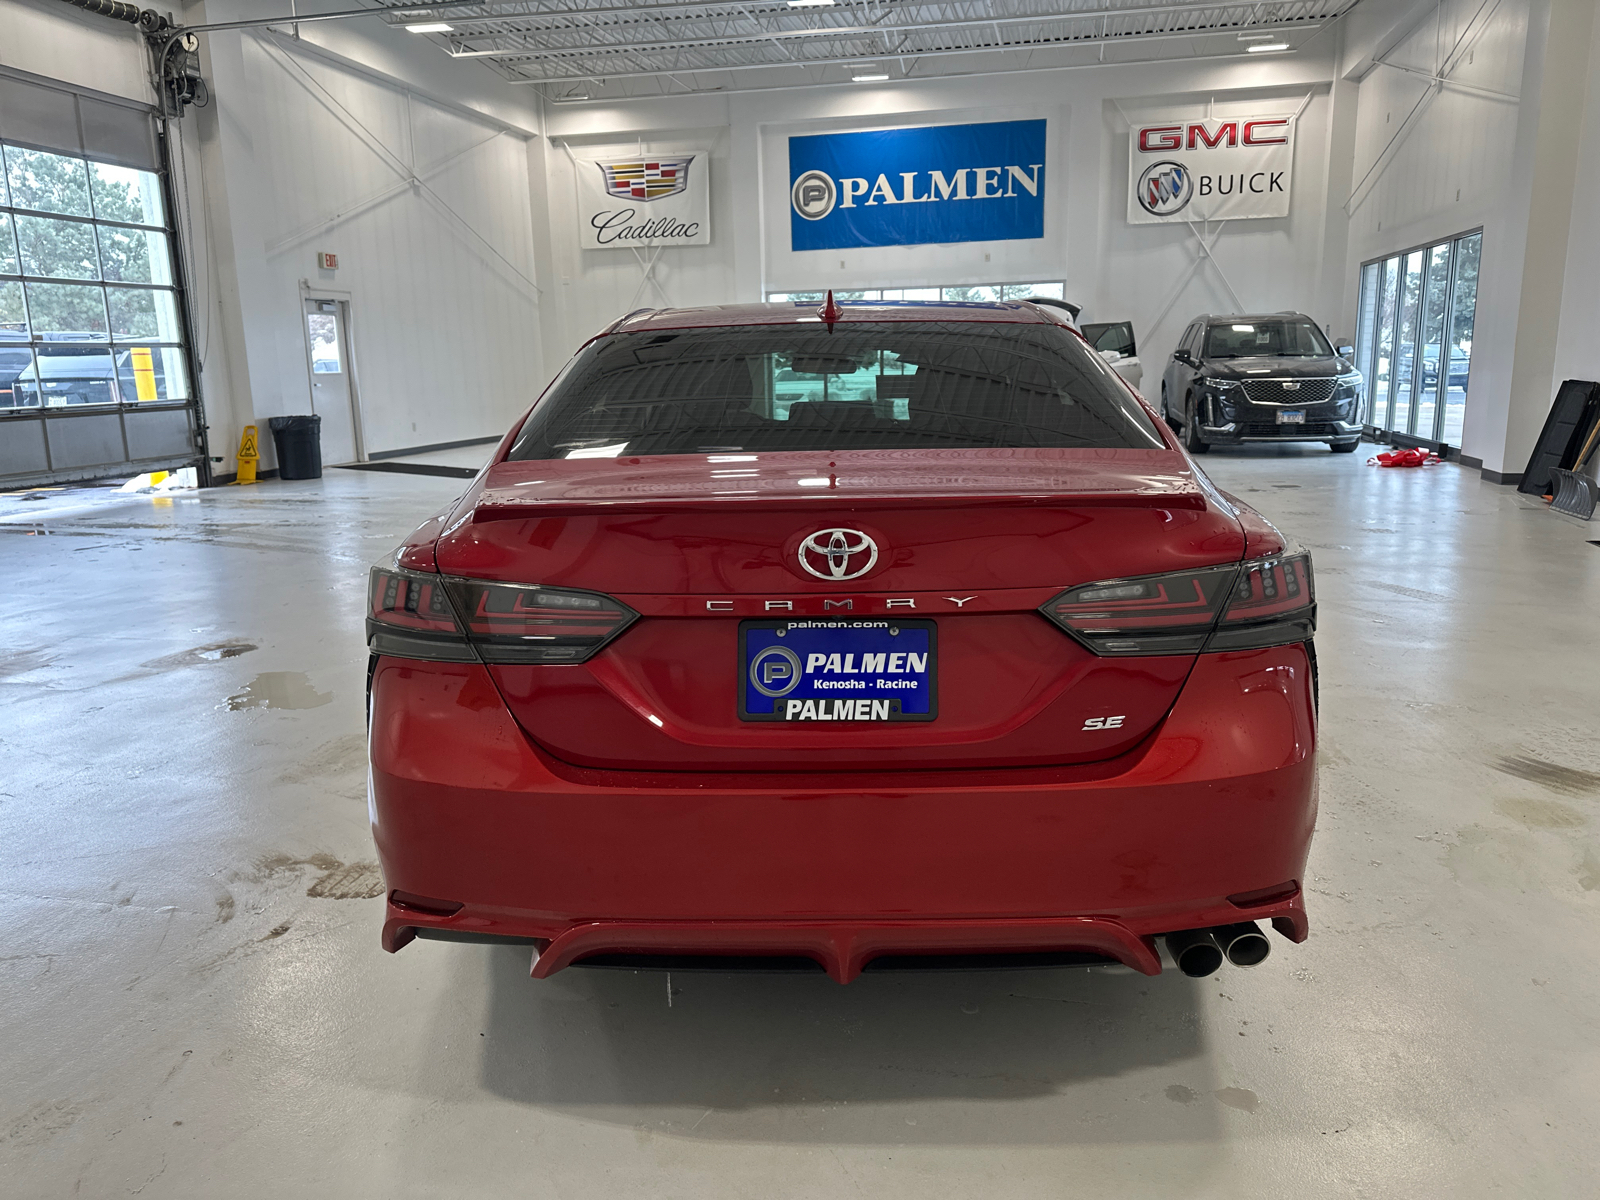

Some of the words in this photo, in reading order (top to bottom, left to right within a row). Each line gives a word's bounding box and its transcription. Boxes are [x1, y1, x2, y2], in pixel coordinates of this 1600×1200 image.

[1138, 118, 1289, 153] GMC
[838, 164, 1043, 208] PALMEN
[1199, 172, 1284, 196] BUICK
[591, 208, 699, 244] Cadillac
[706, 595, 978, 611] CAMRY
[787, 620, 889, 630] palmen.com
[805, 652, 928, 674] PALMEN
[813, 679, 866, 690] Kenosha
[876, 679, 918, 690] Racine
[785, 699, 890, 721] PALMEN
[1081, 715, 1126, 731] SE
